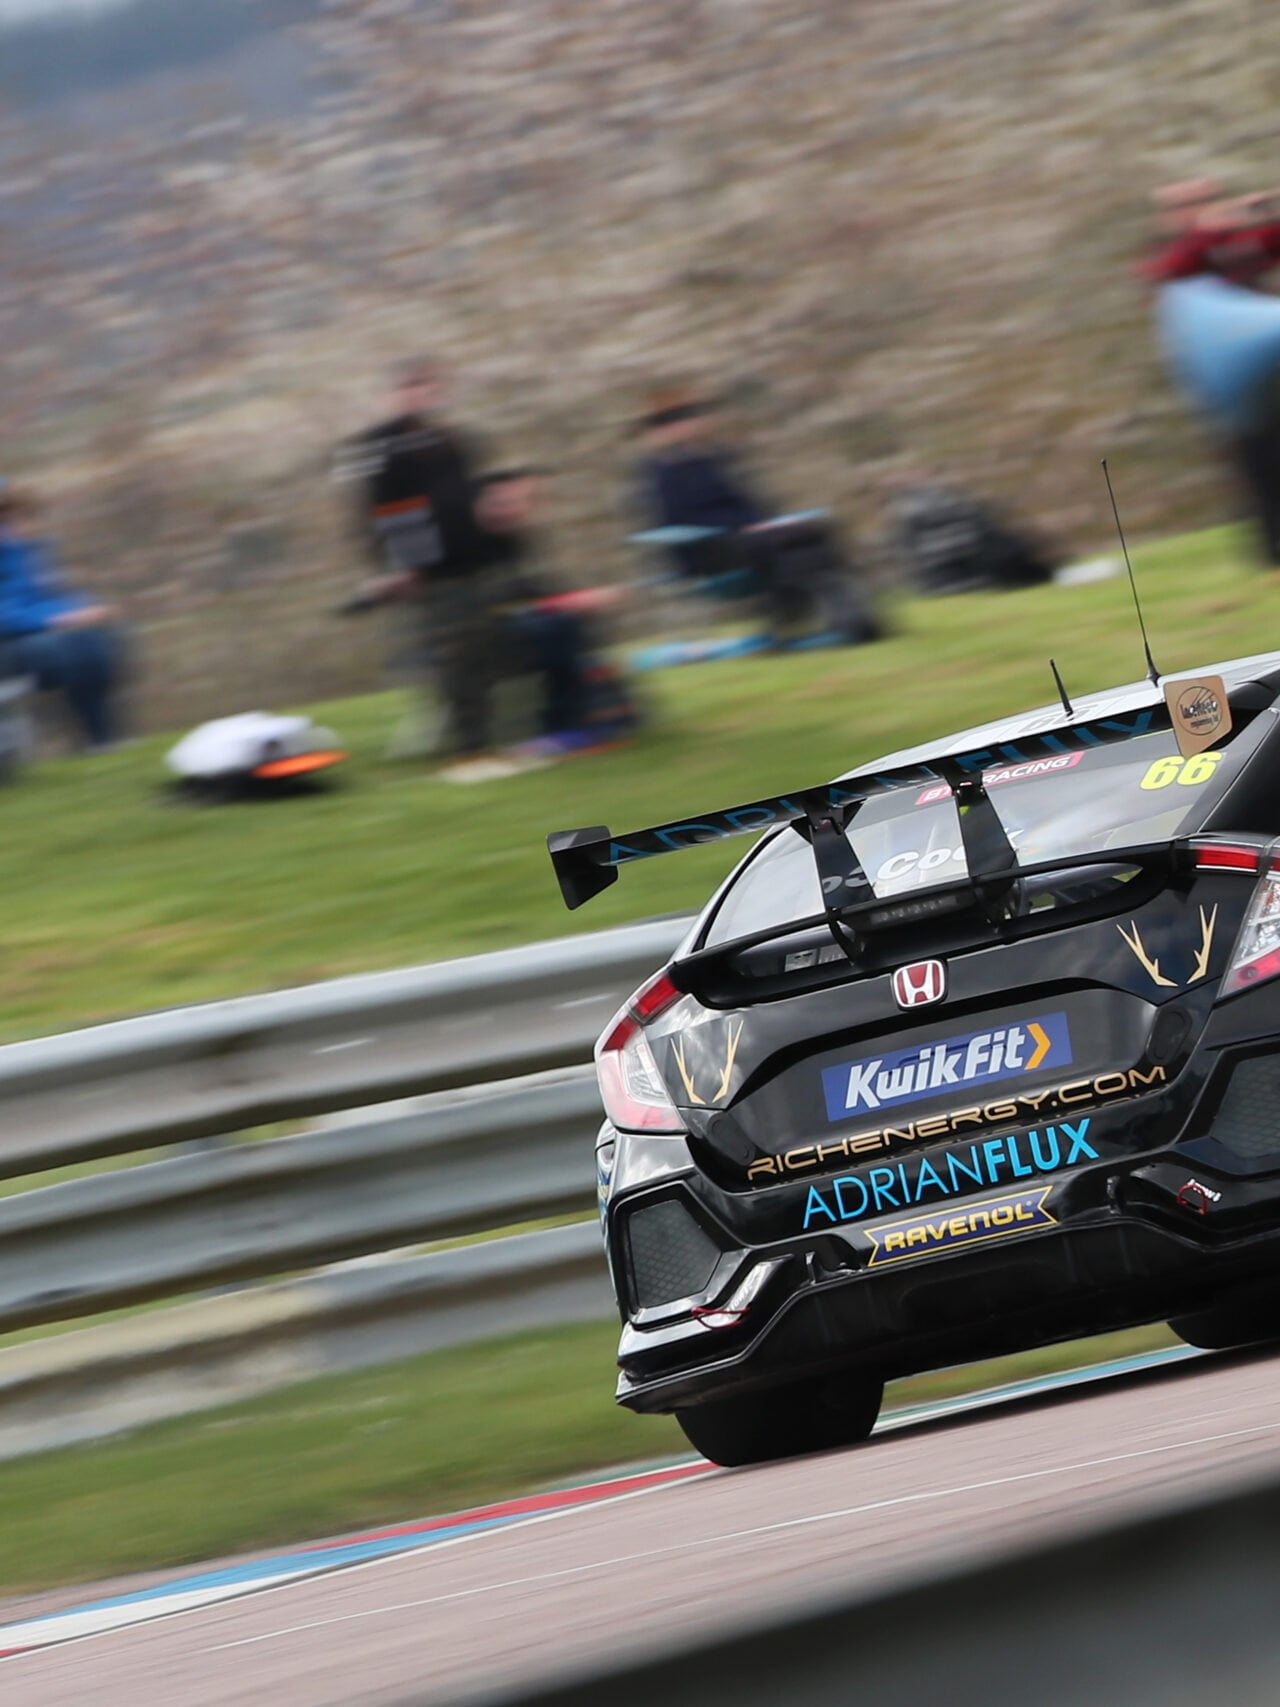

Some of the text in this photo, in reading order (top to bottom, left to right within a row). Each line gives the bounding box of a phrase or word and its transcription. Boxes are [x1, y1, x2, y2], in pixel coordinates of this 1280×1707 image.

[982, 756, 1071, 785] RACING
[1140, 751, 1222, 790] 66
[747, 1066, 1167, 1180] RICHENERGY.COM
[884, 1205, 1029, 1253] RAVENOL
